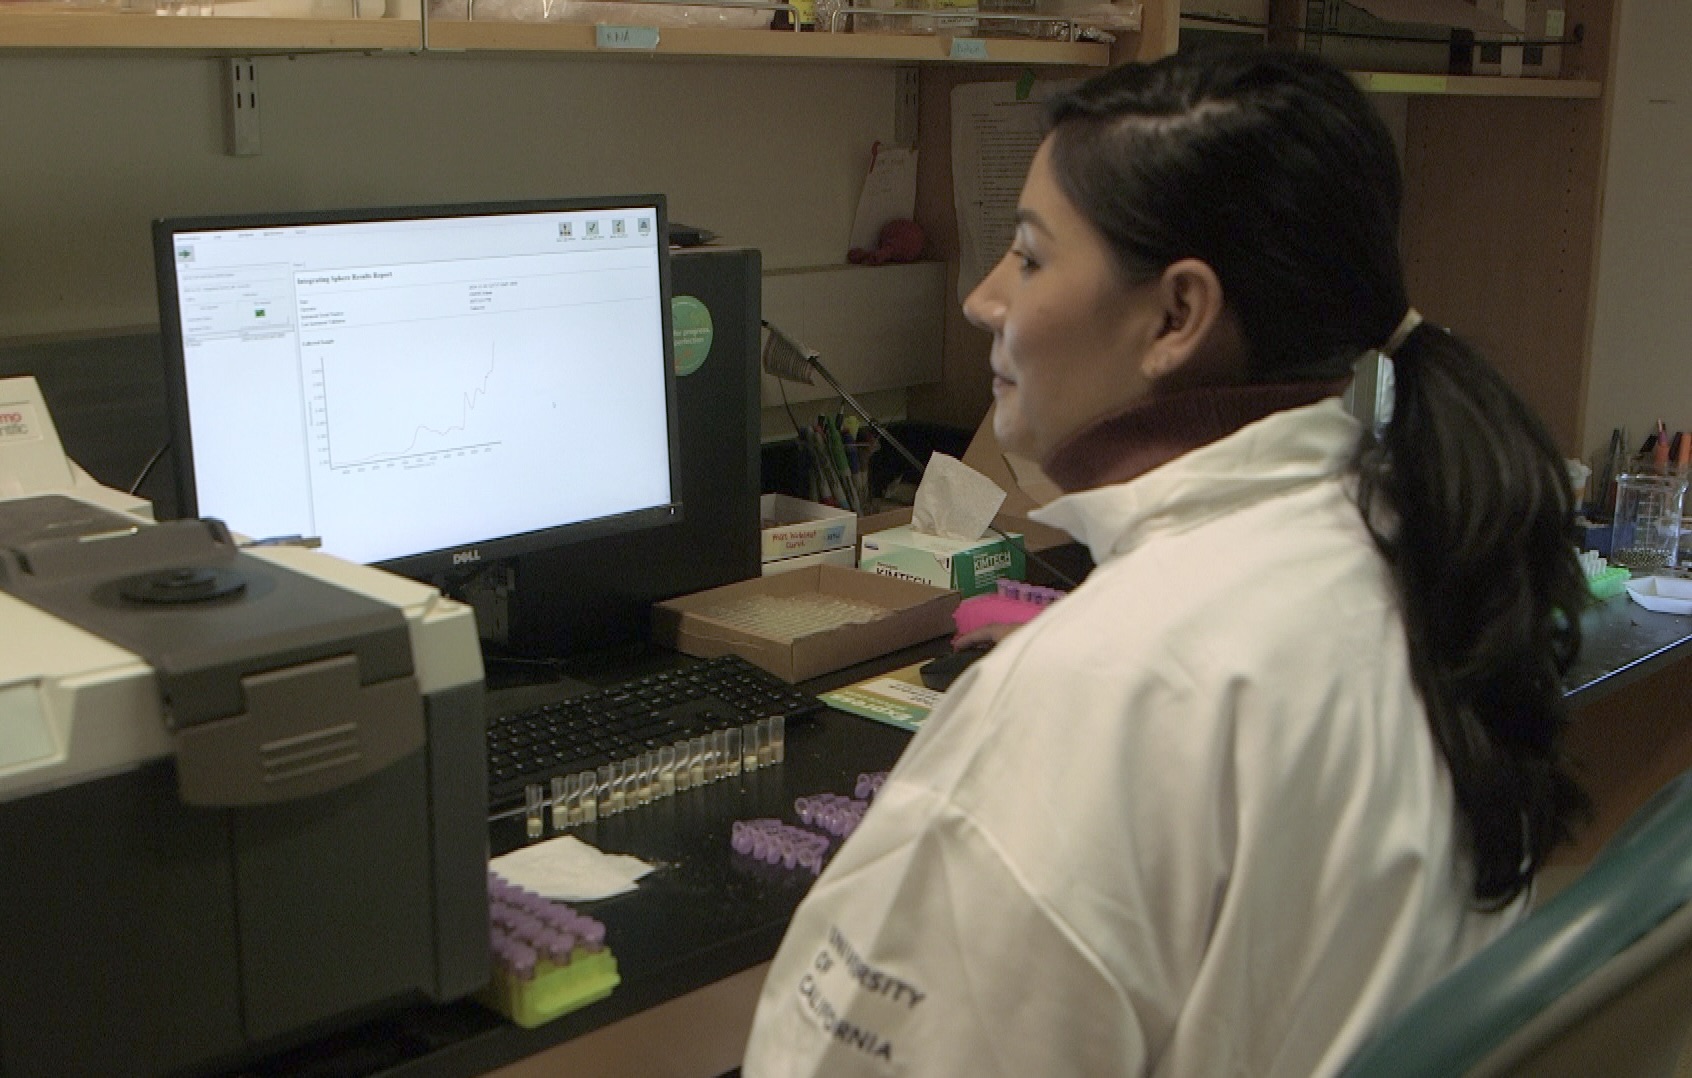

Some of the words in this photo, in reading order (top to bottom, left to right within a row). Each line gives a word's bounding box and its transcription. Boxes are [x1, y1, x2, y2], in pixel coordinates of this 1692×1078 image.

[297, 277, 330, 286] Integrating
[373, 271, 392, 281] Report
[453, 549, 481, 565] DELL
[974, 551, 1012, 571] KIMTECH
[829, 925, 926, 1010] UNIVERSITY
[799, 973, 892, 1063] CALIFORNIA
